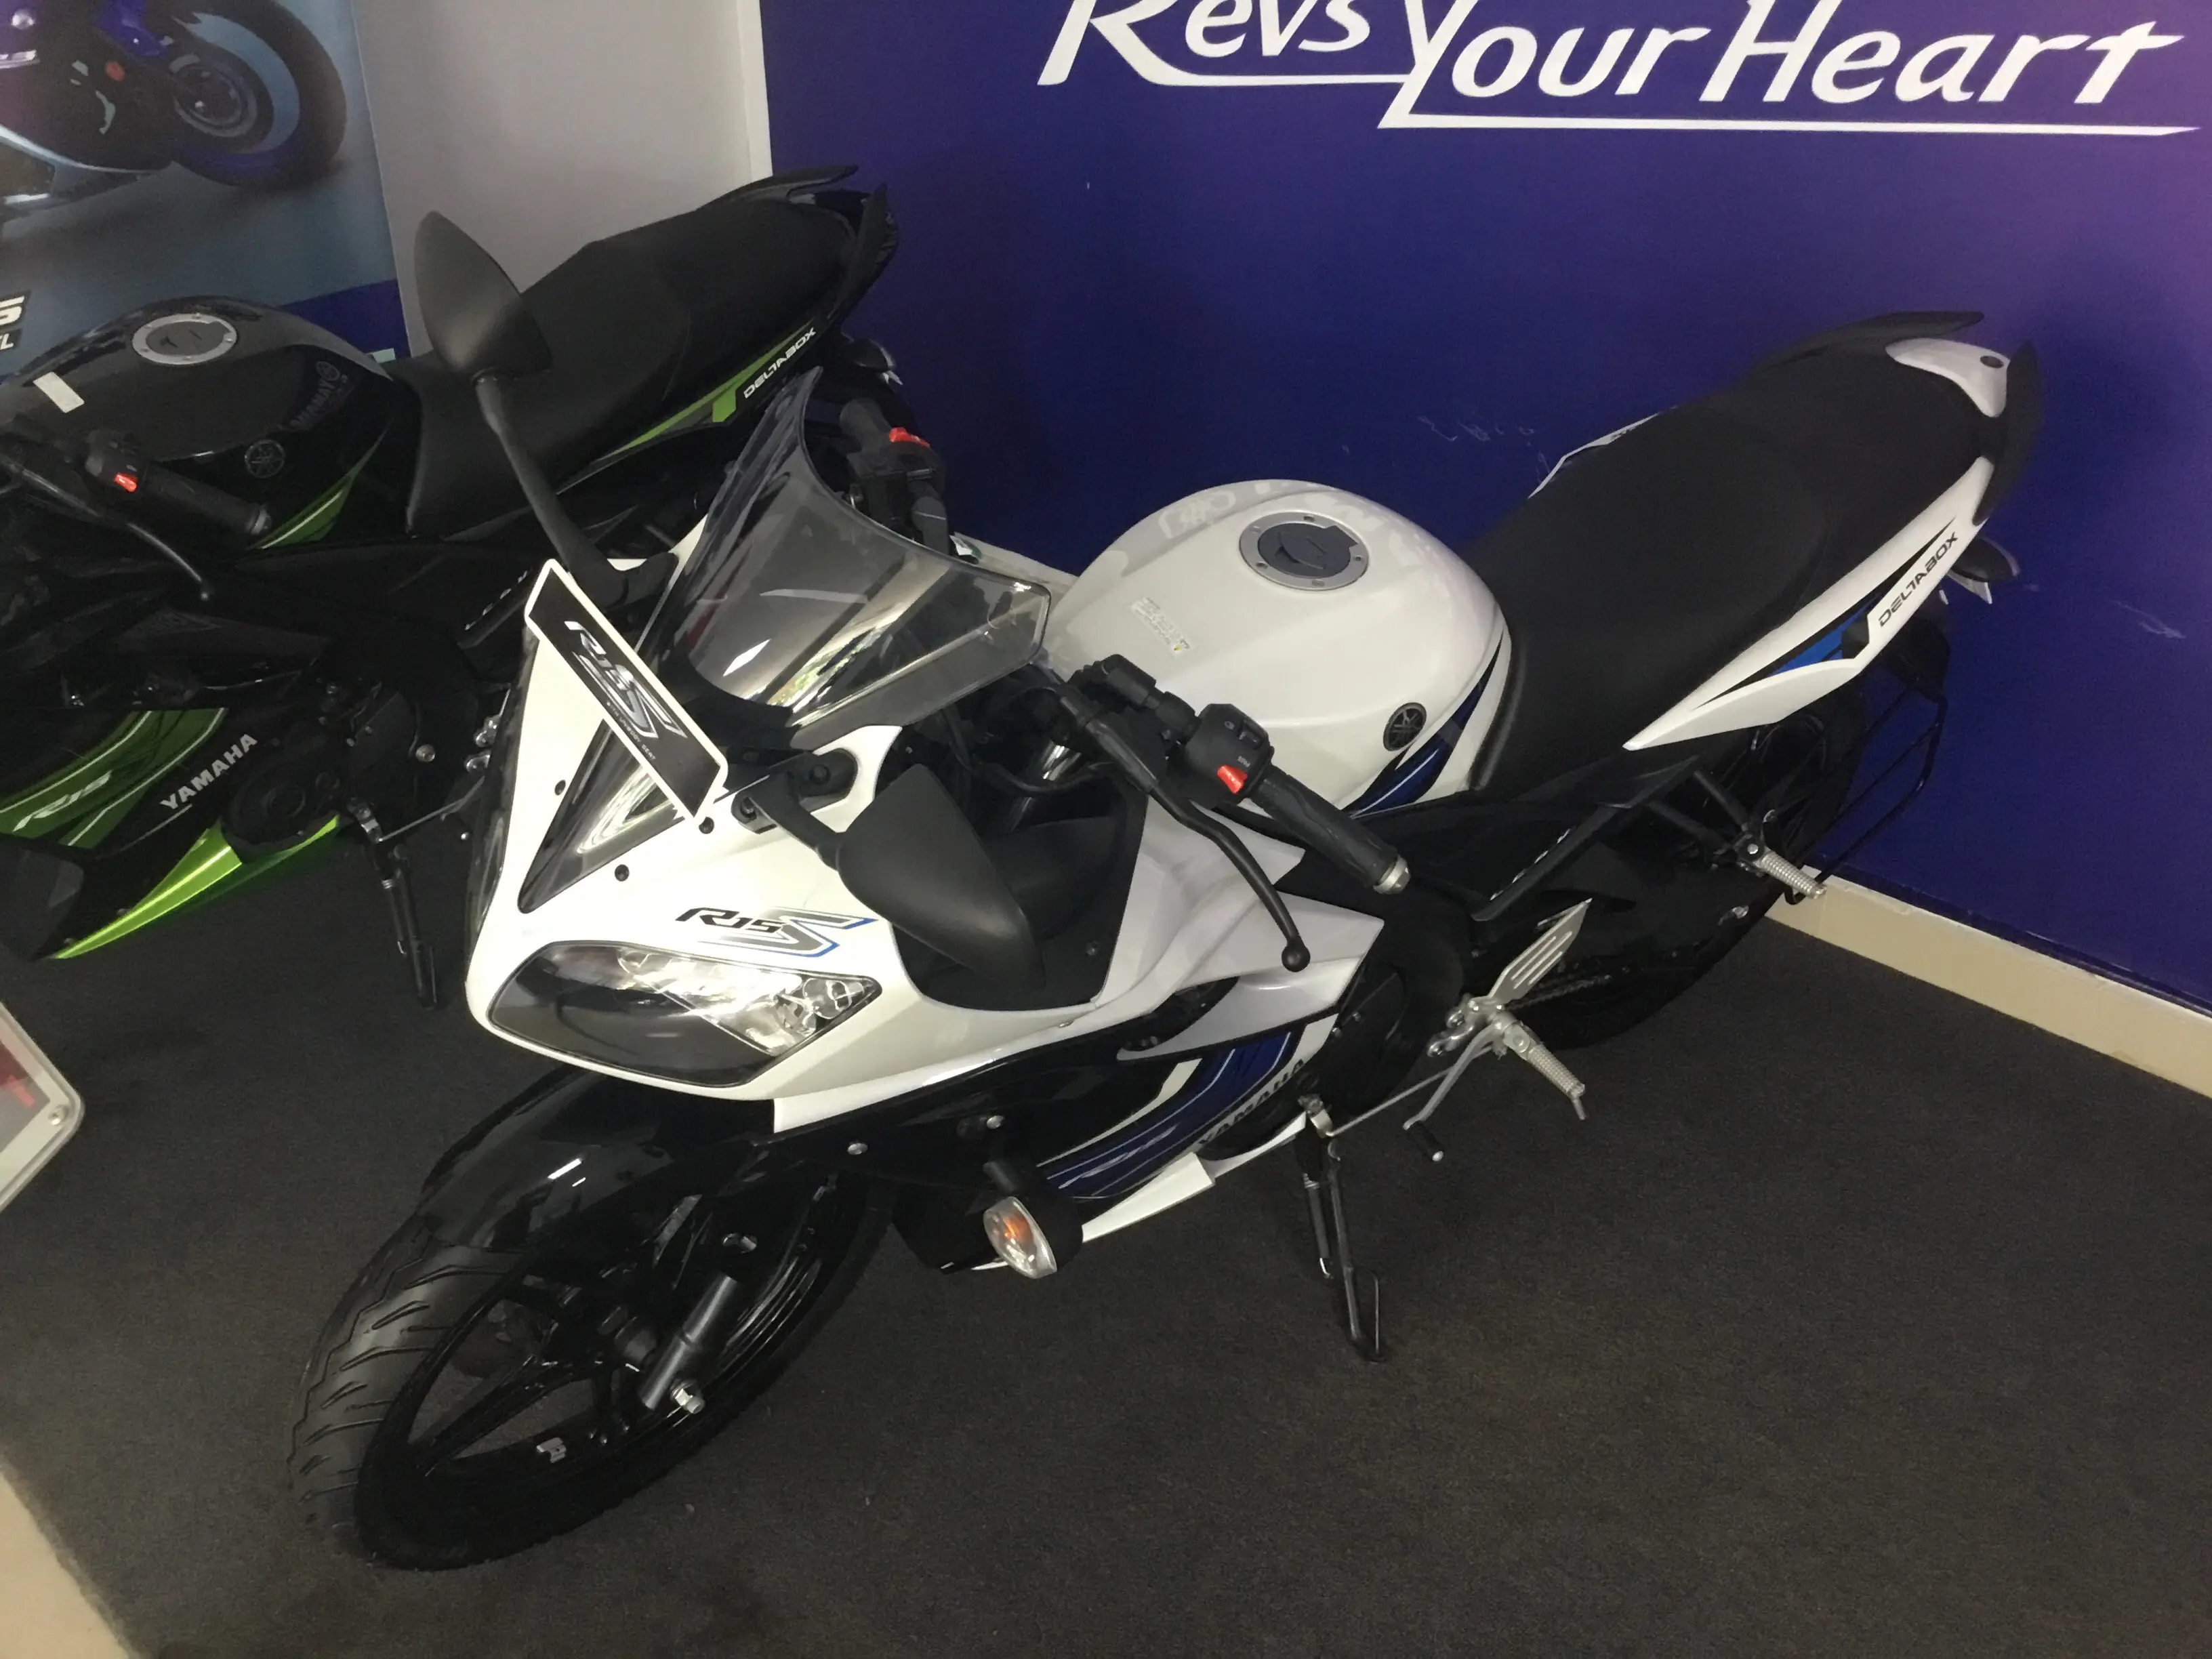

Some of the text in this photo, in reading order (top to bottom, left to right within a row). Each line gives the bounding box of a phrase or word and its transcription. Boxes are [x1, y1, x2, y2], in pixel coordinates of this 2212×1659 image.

[1037, 0, 2186, 129] Revs Your Heart
[743, 327, 816, 398] DELTABOX
[1878, 525, 1959, 628] DELTABOX
[159, 733, 258, 810] YAMAHA
[641, 743, 657, 760] SEAT
